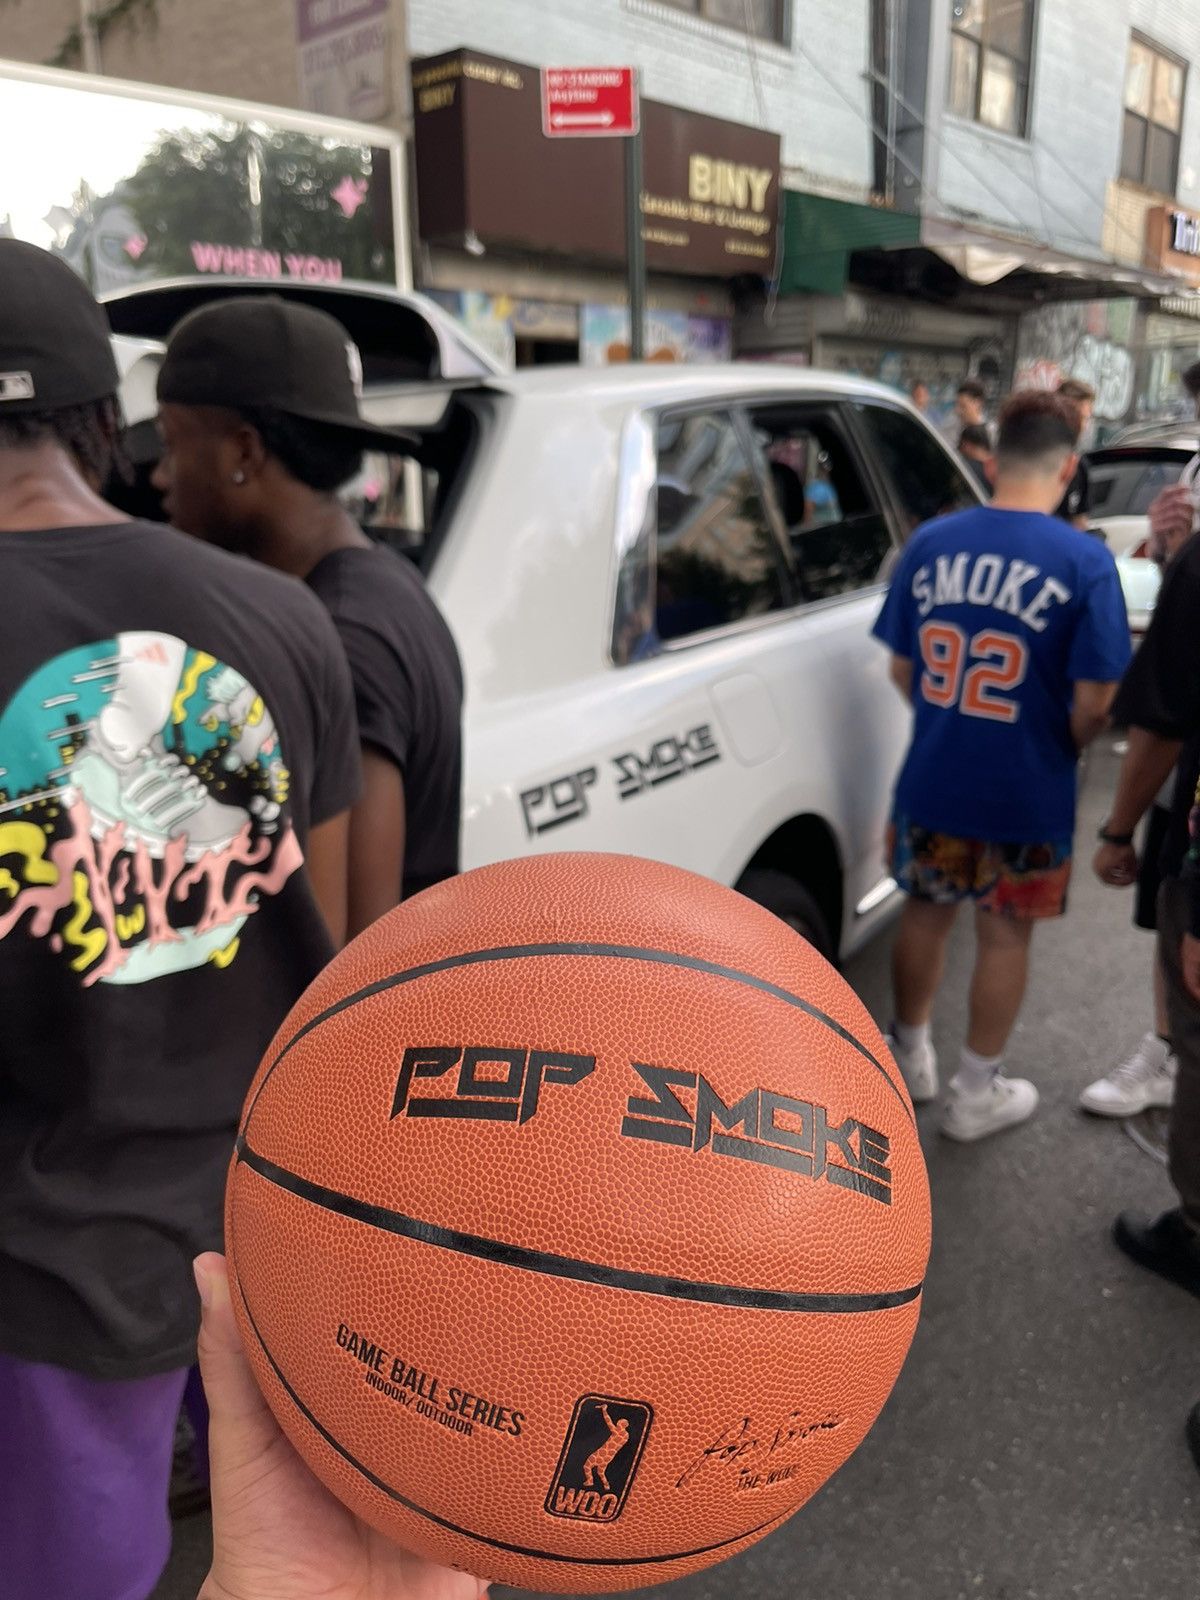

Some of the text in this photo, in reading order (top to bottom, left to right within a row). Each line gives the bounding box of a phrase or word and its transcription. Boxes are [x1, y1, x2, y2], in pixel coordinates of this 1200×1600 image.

[689, 154, 773, 213] BINY
[191, 240, 343, 282] WHEN YOU
[911, 551, 1072, 633] SMOKE
[918, 618, 1031, 724] 92
[519, 723, 720, 840] POP SMOKE
[389, 1046, 892, 1206] POP SMOKE
[336, 1322, 526, 1437] GAME BALL SERIES
[416, 1399, 475, 1437] OUTDOOR
[554, 1485, 618, 1518] WOO
